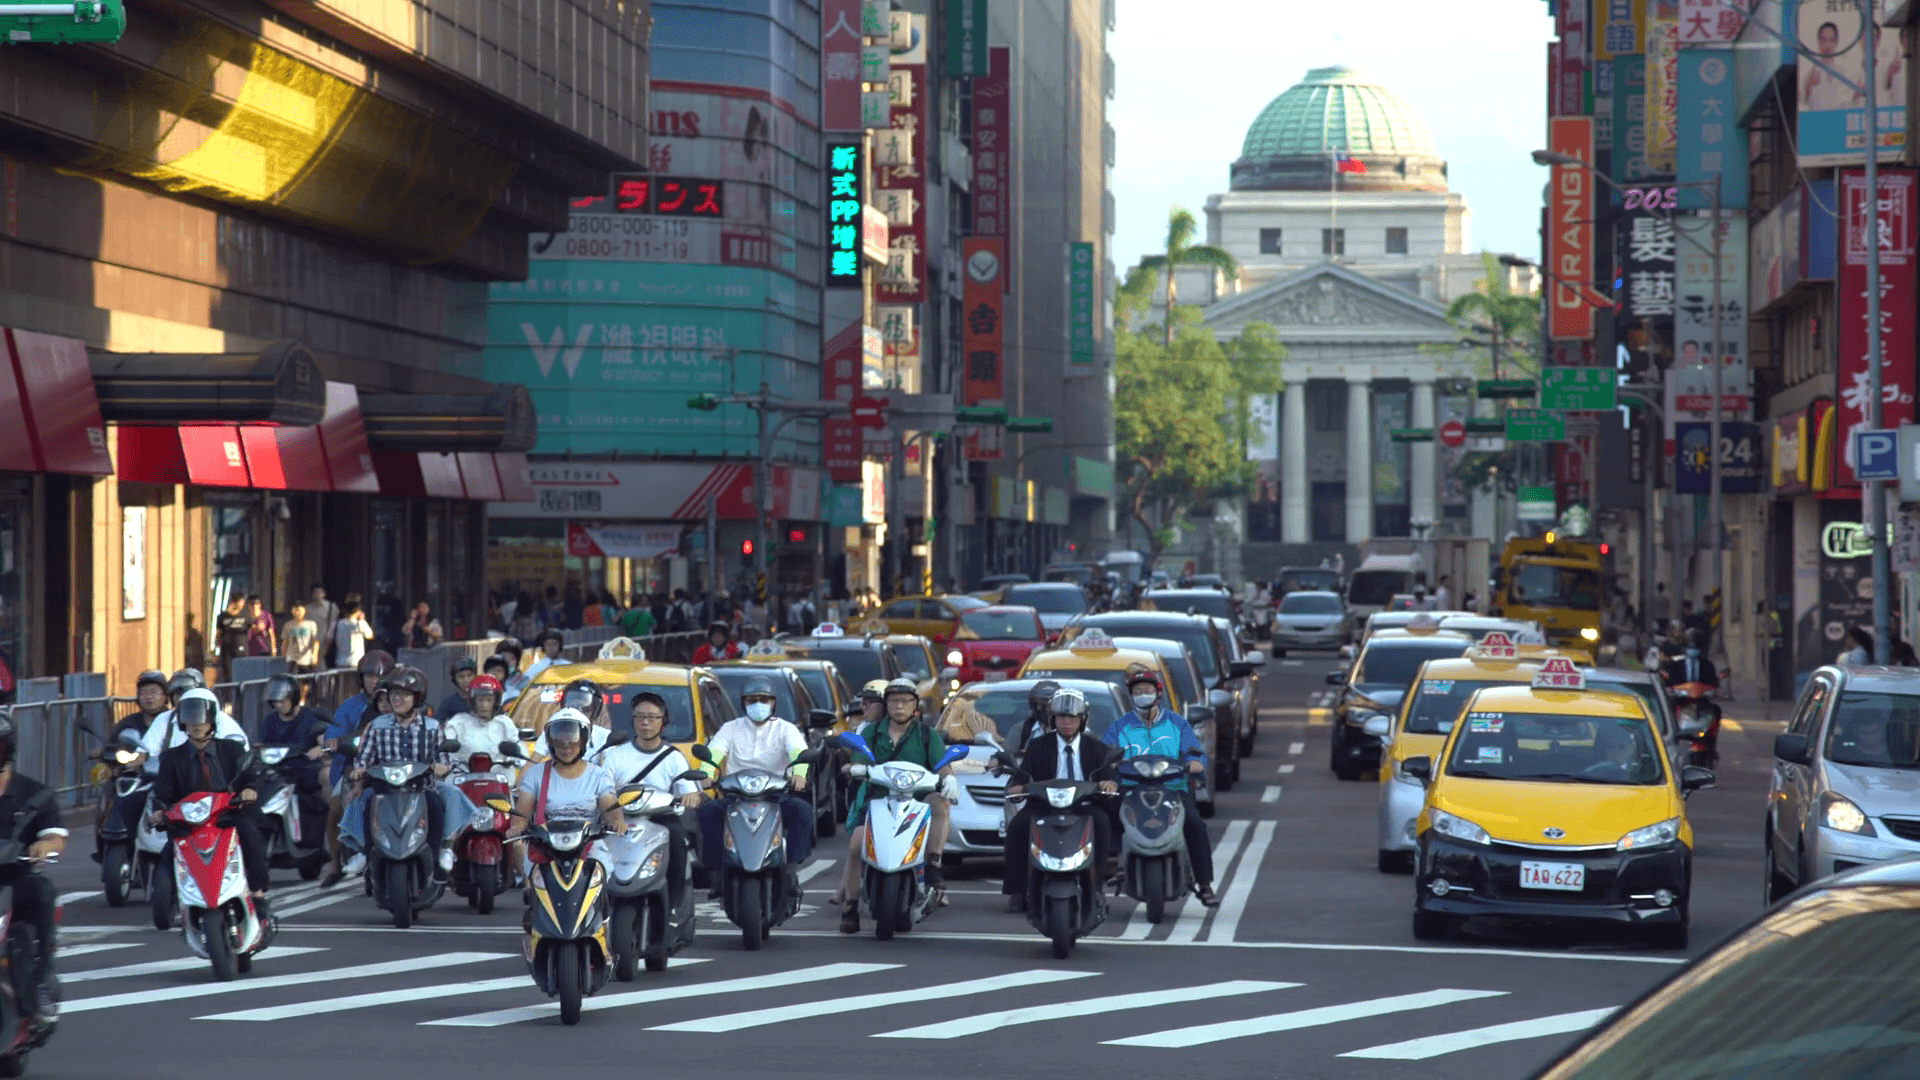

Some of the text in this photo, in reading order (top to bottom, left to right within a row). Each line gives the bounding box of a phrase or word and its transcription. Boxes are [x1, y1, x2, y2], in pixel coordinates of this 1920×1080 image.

[568, 216, 688, 236] 0800-000-119
[1557, 147, 1582, 309] ORANGE
[566, 239, 688, 259] 0800-711-119
[1720, 437, 1752, 464] 24
[1862, 435, 1893, 466] P
[1536, 674, 1580, 686] 大都會
